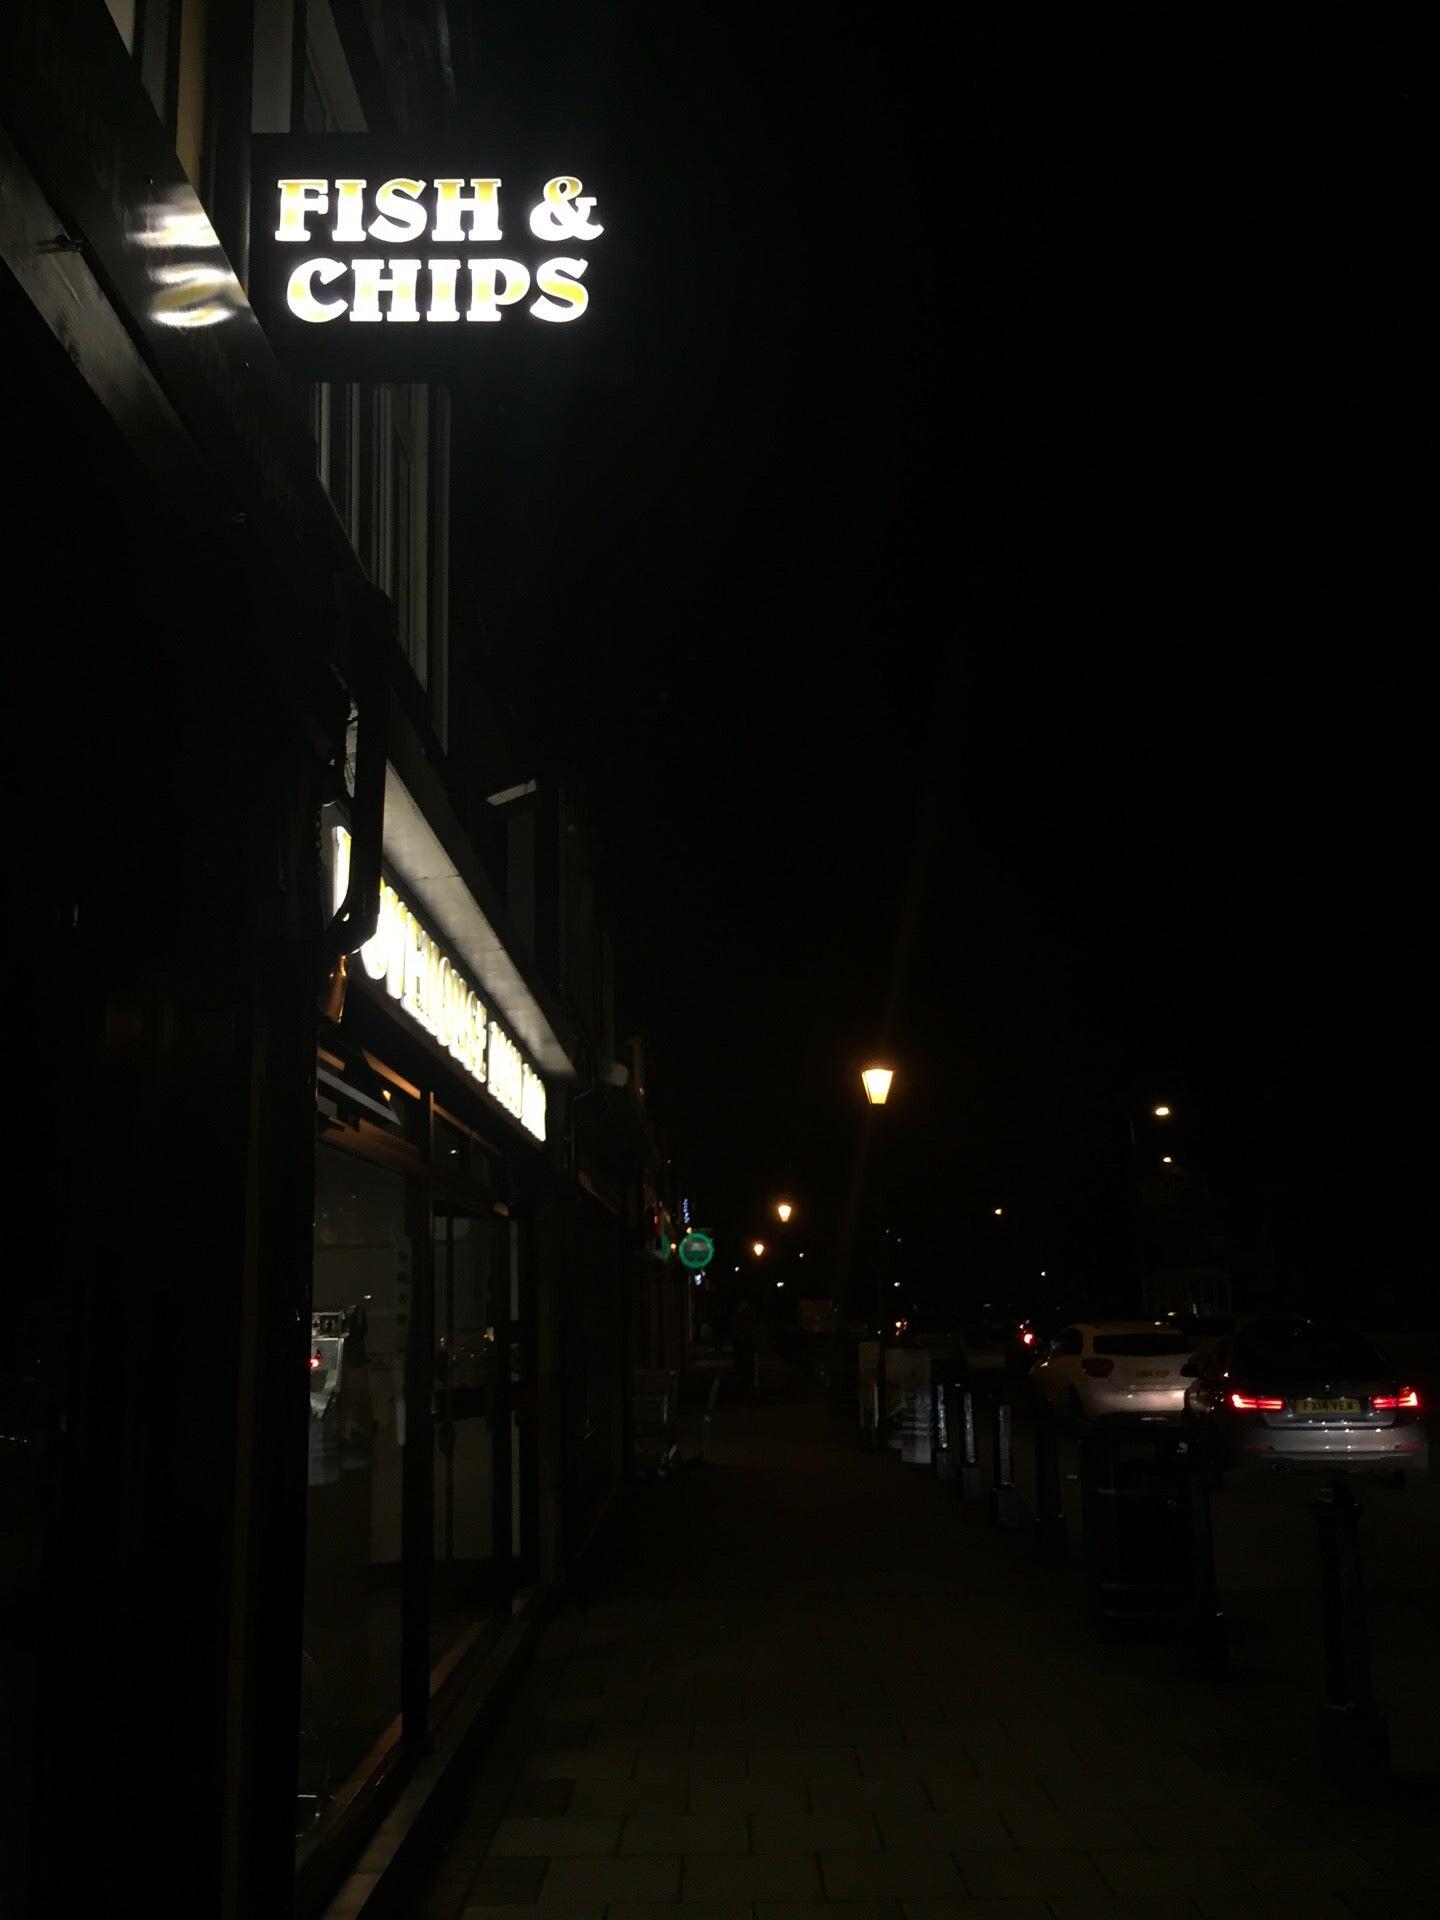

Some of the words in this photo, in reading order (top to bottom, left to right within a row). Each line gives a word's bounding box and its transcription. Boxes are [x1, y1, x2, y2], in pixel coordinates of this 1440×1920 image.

[274, 178, 502, 243] FISH
[529, 175, 605, 241] &
[286, 256, 590, 323] CHIPS
